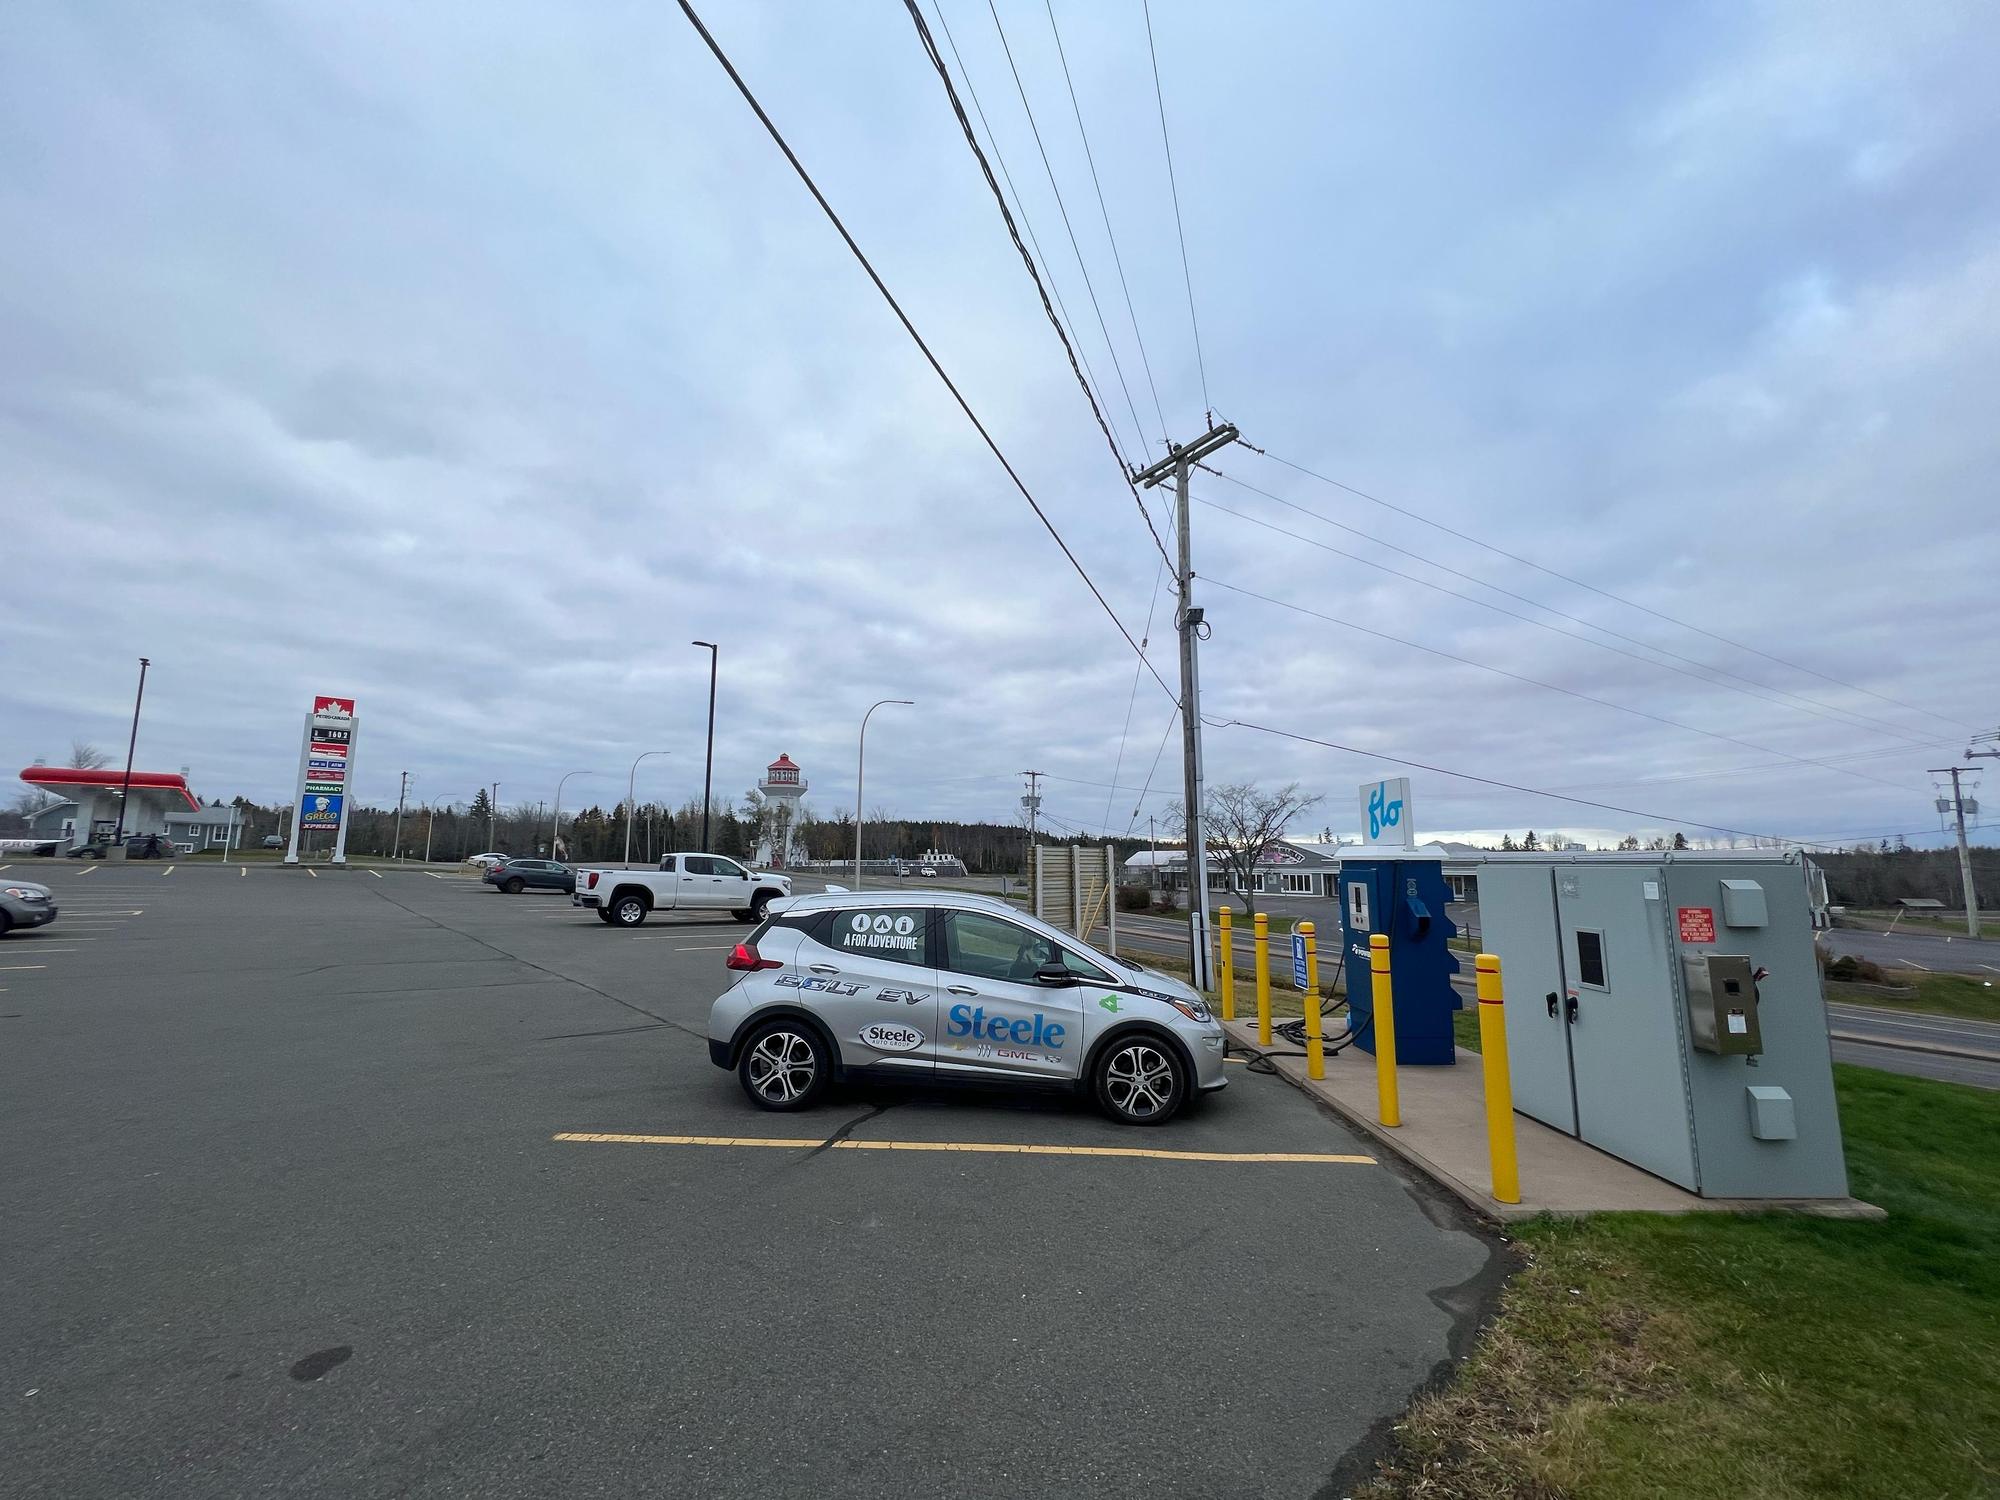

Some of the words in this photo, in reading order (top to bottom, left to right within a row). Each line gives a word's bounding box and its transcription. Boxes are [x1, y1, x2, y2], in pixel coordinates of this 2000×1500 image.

[305, 812, 337, 820] GRECO
[1368, 781, 1403, 839] flo
[843, 933, 850, 946] A
[851, 934, 867, 947] FOR
[867, 934, 918, 950] ADVENTURE
[774, 973, 869, 996] BOLT
[876, 987, 930, 1005] EV
[947, 1004, 1066, 1049] Steele
[869, 1027, 916, 1043] Steele
[872, 1038, 888, 1046] AUTO
[997, 1048, 1038, 1061] GMC
